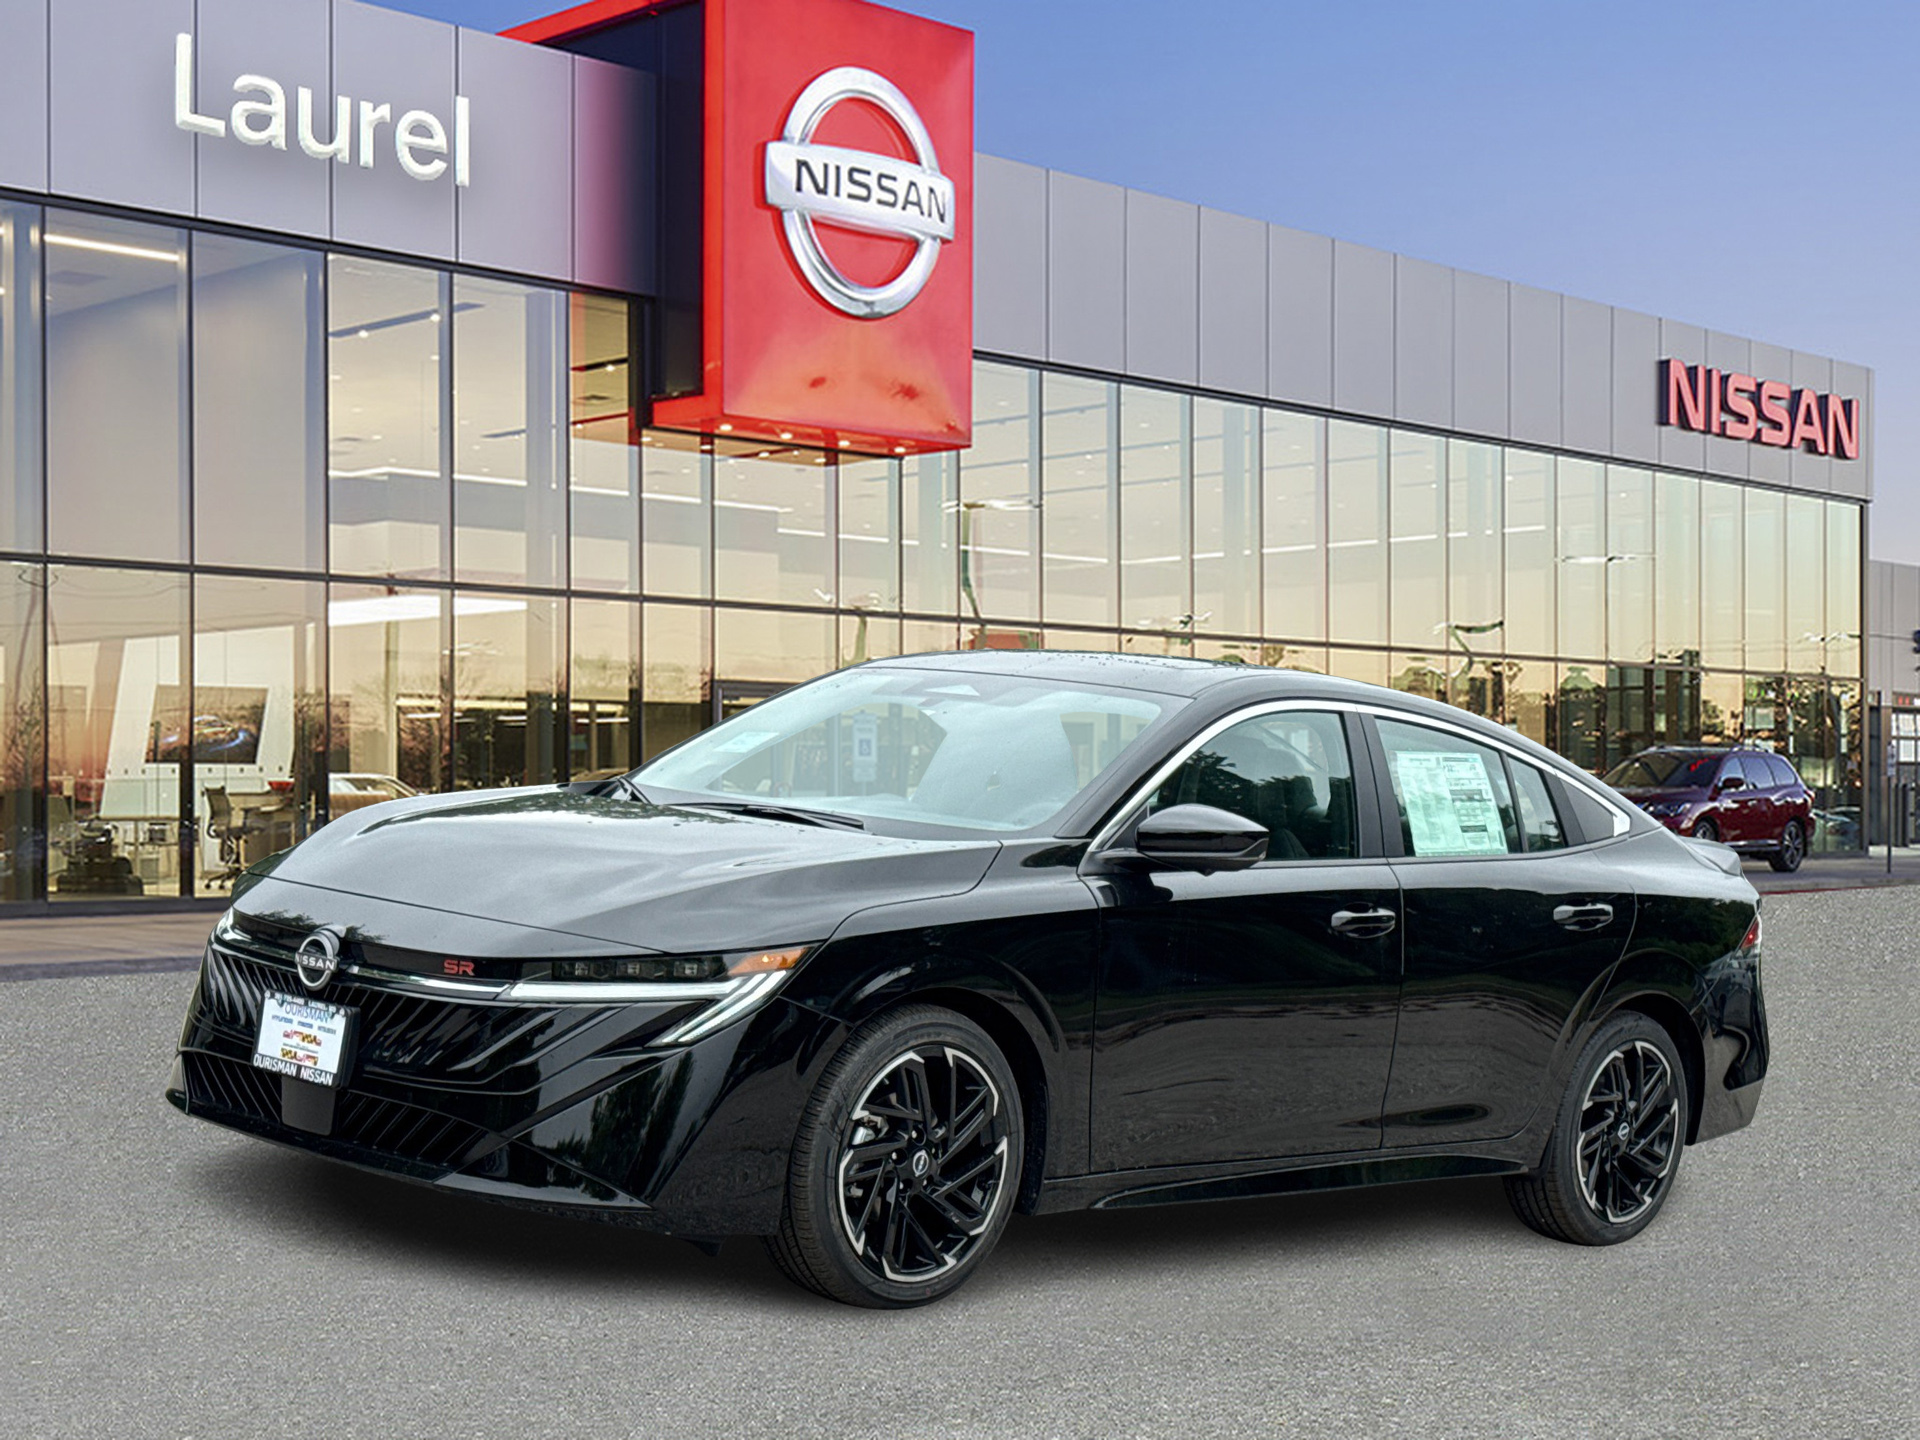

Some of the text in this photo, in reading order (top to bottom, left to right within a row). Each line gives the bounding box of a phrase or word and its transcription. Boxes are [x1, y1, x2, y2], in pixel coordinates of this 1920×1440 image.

[175, 32, 470, 188] Laurel
[794, 158, 947, 224] NISSAN
[1660, 358, 1860, 460] NISSAN
[443, 959, 475, 977] SR
[284, 1003, 330, 1024] OURISMAN
[253, 1053, 334, 1087] OURISMAN NISSAN
